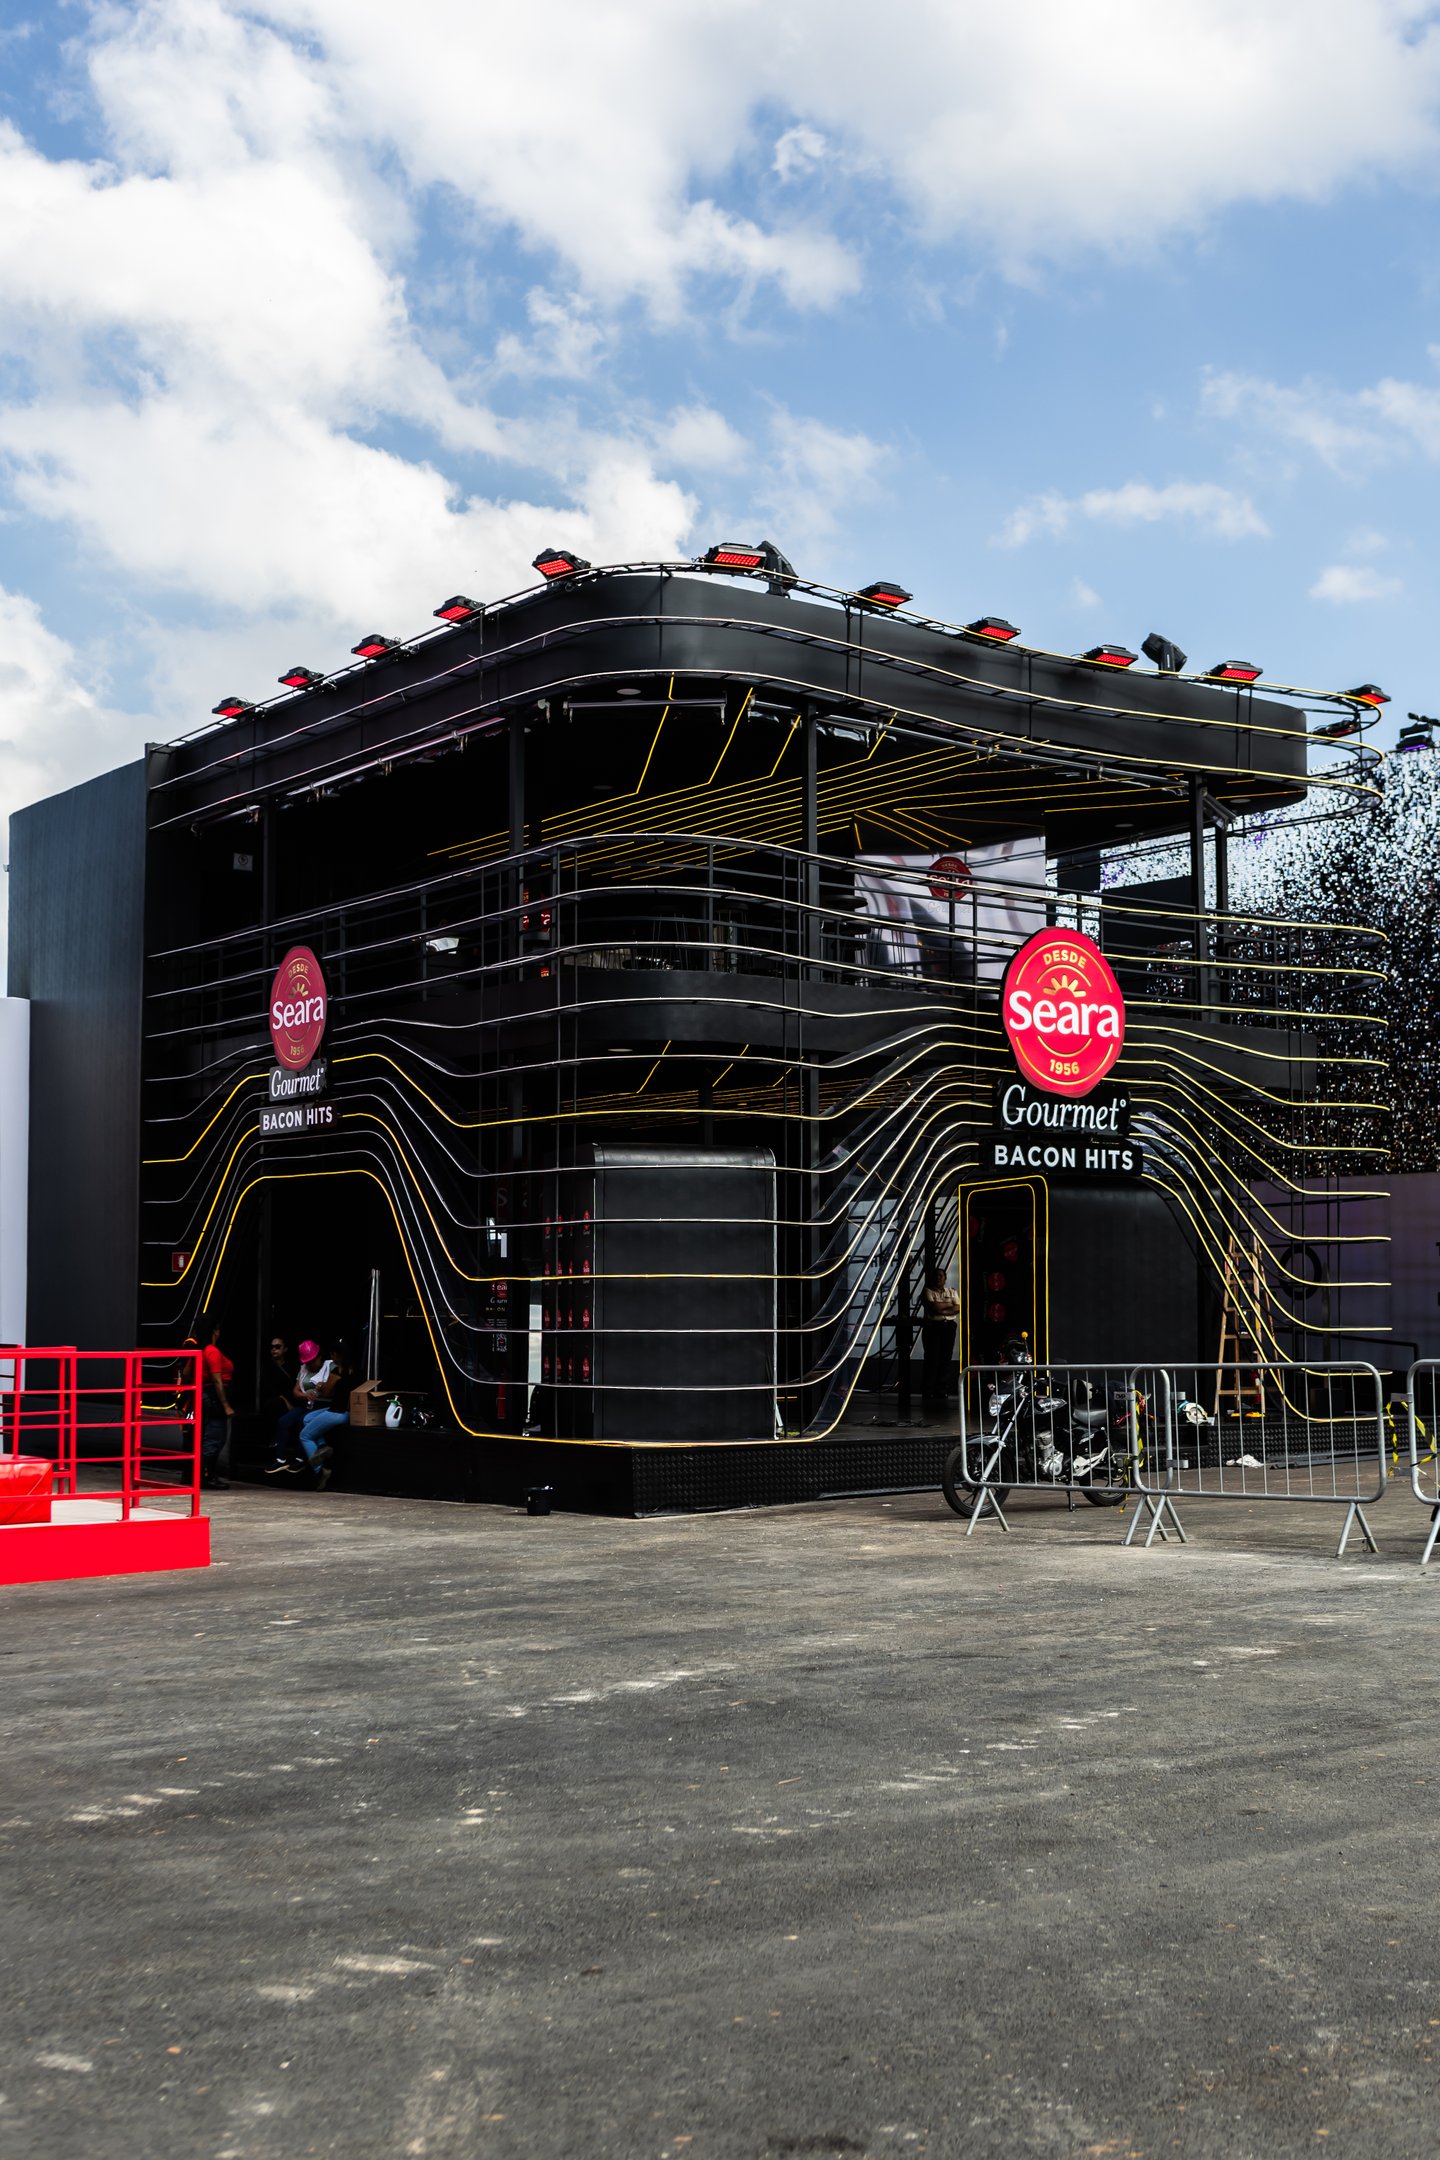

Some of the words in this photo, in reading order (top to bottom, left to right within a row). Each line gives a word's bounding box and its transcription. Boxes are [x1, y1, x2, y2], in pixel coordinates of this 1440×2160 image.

[1043, 949, 1087, 969] DESDE
[288, 963, 309, 979] DESDE
[272, 996, 324, 1030] Seara
[1008, 990, 1120, 1038] Seara
[290, 1044, 305, 1056] 1956
[1050, 1059, 1080, 1076] 1956
[262, 1109, 302, 1131] BACON
[306, 1105, 333, 1126] HITS
[994, 1144, 1076, 1168] BACON
[1085, 1148, 1134, 1171] HITS
